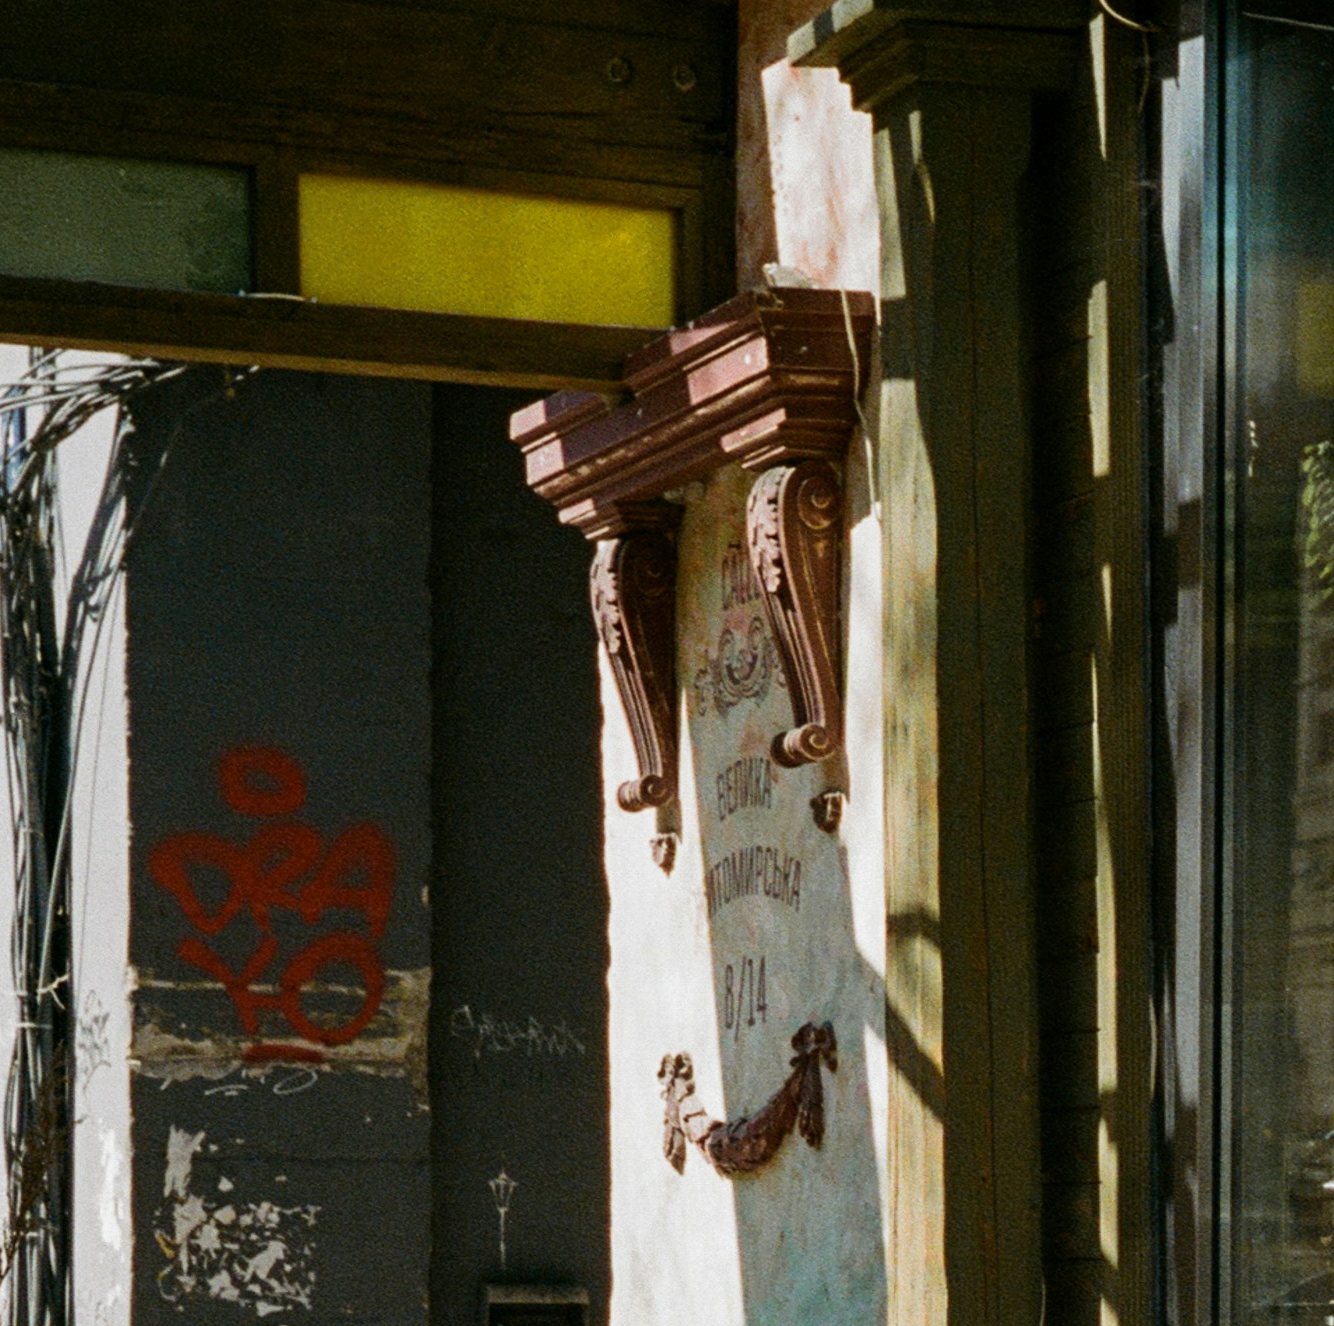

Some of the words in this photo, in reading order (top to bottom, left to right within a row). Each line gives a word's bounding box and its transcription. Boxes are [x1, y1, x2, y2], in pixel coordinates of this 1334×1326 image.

[715, 756, 773, 822] ВЕЛИКА
[703, 845, 802, 920] ИТОМИРСЬКА
[724, 955, 768, 1043] 8/14
